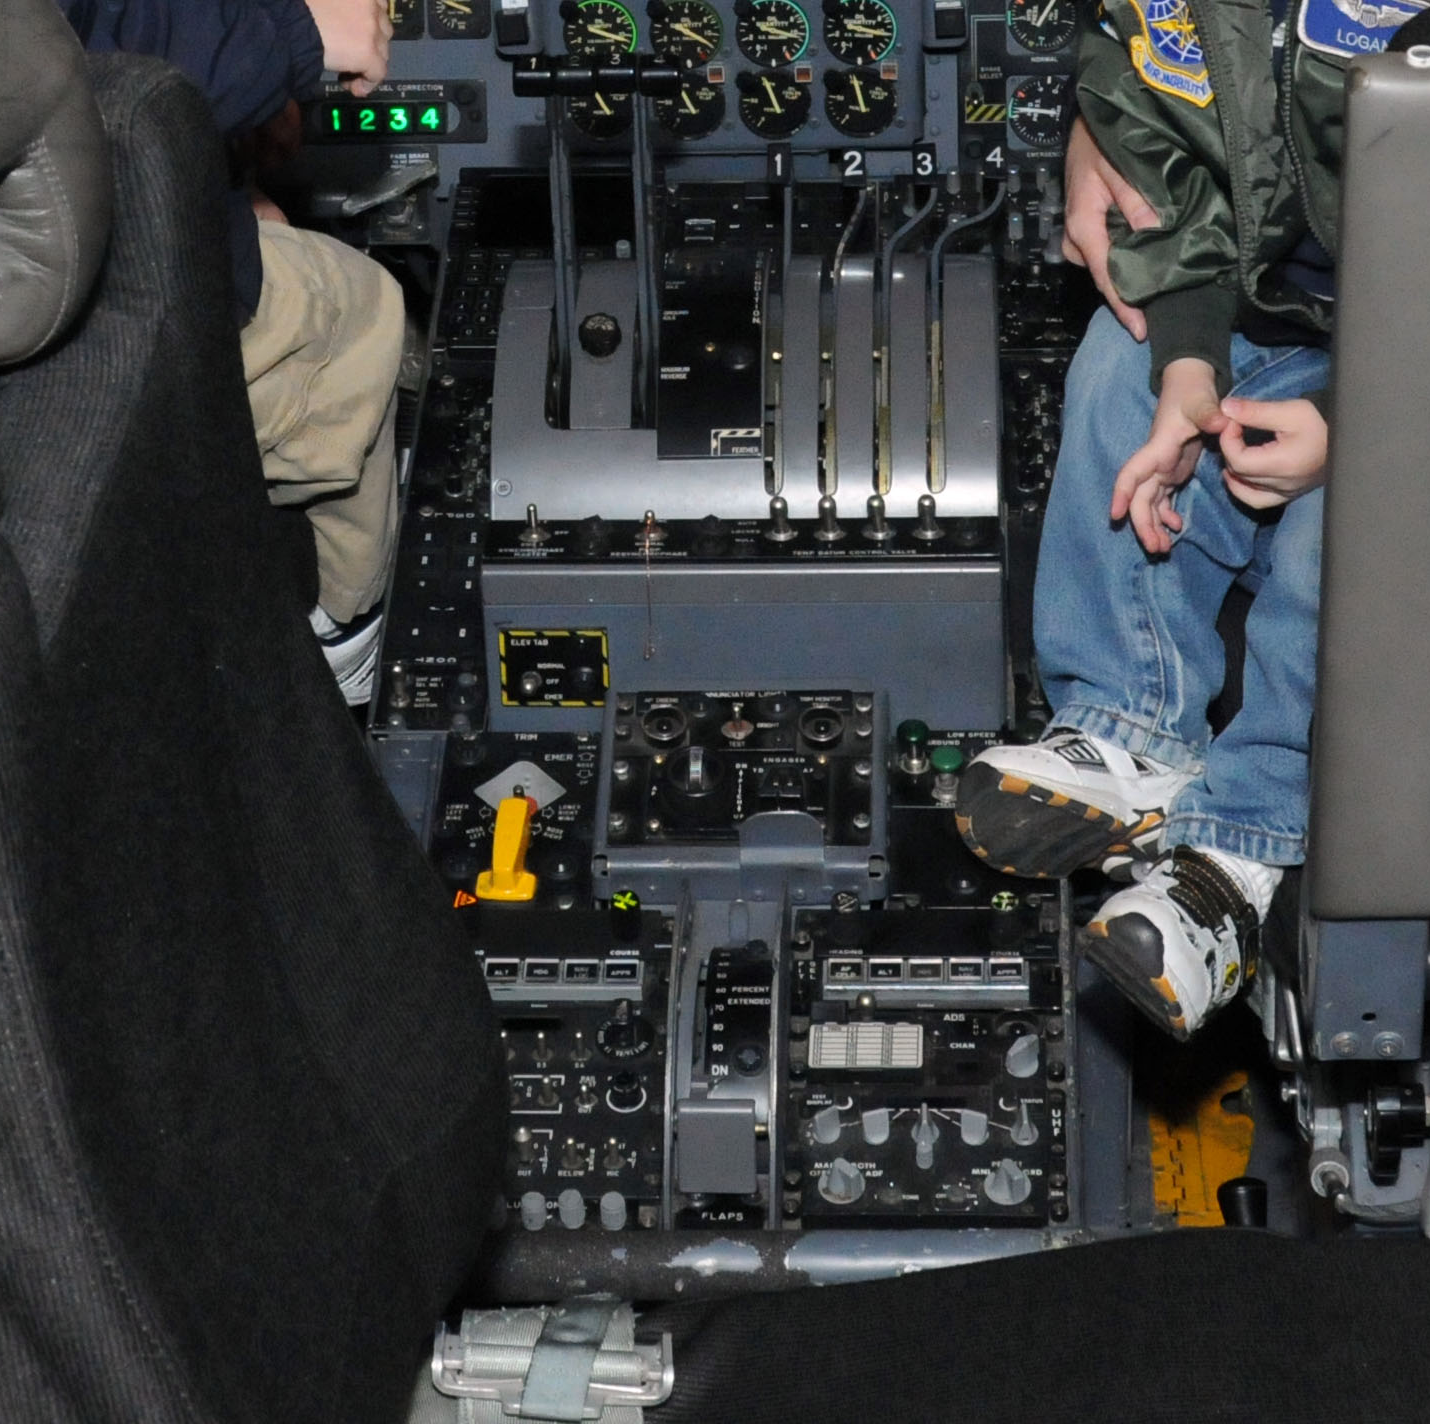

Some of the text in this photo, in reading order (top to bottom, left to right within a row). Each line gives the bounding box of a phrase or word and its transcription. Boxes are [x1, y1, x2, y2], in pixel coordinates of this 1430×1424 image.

[530, 57, 537, 69] 1
[611, 52, 620, 65] 3
[378, 83, 444, 92] UEL CORRECTION
[1162, 71, 1206, 95] MOBILITY
[332, 108, 439, 130] 1 2 3 4
[986, 146, 1004, 168] 4
[774, 153, 782, 176] 1
[844, 151, 863, 176] 2
[916, 153, 933, 175] 3
[732, 446, 759, 454] FEATHER
[715, 1003, 724, 1011] 70
[943, 1013, 965, 1022] ADS
[713, 1023, 724, 1031] 80
[712, 1043, 724, 1051] 90
[711, 1065, 729, 1075] DN
[1052, 1109, 1061, 1136] UHF
[865, 1169, 883, 1177] ADF
[701, 1212, 744, 1221] FLAPS
